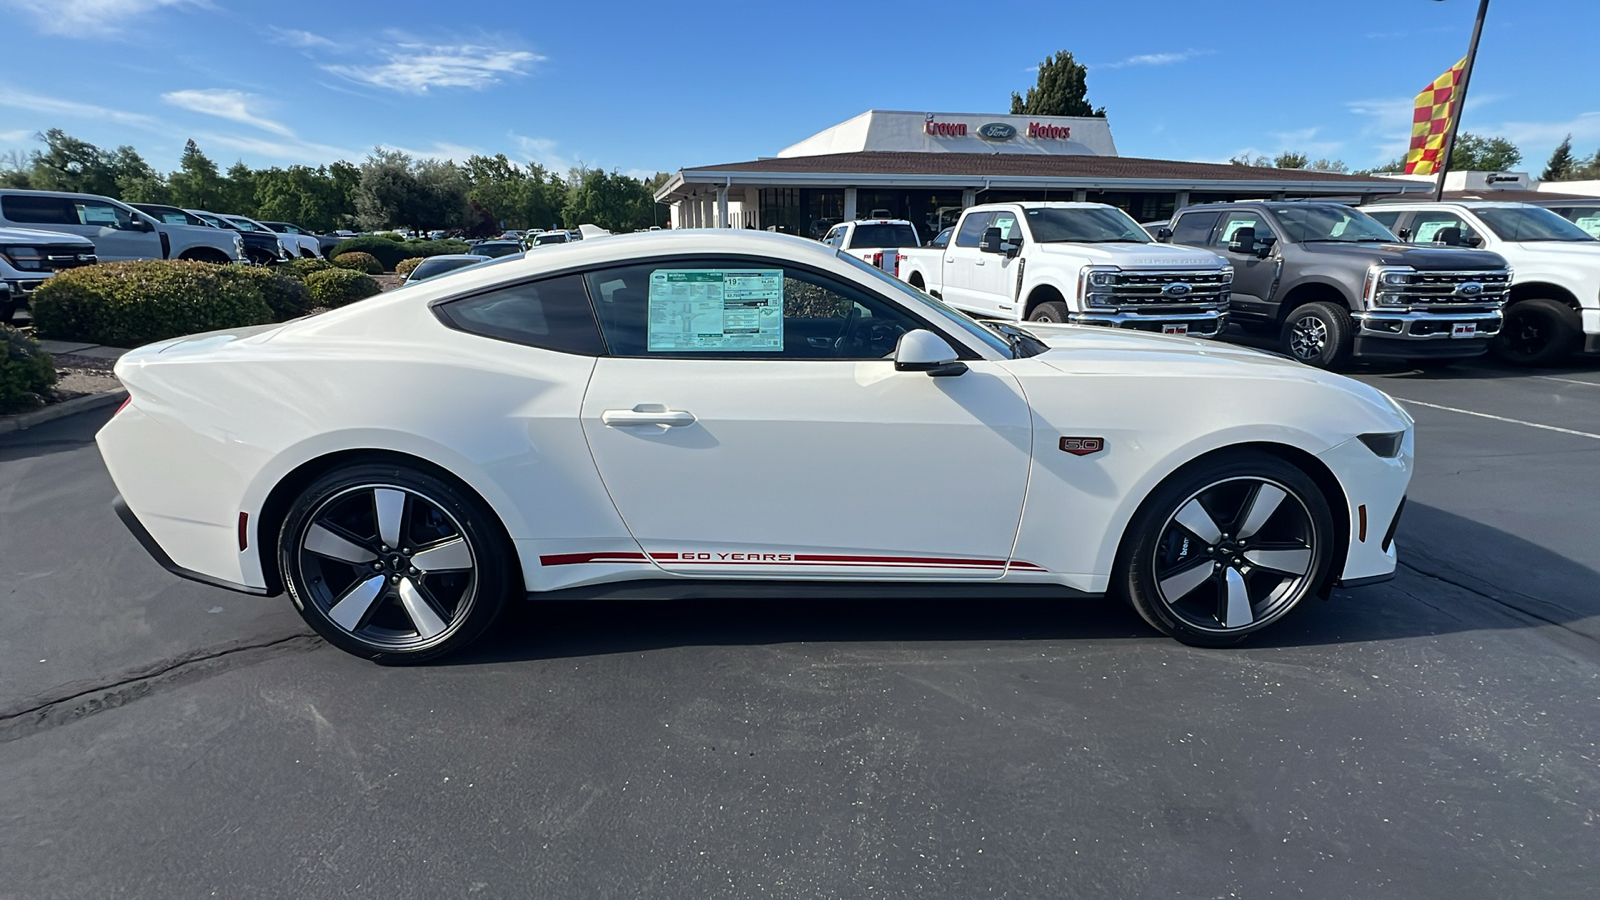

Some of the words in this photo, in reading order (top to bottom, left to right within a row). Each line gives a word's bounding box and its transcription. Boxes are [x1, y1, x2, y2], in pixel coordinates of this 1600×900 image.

[926, 119, 968, 136] Crown
[987, 126, 1010, 137] Ford
[1028, 122, 1071, 139] Motors
[1064, 439, 1100, 450] 5.0
[1179, 537, 1189, 556] brem
[681, 552, 711, 560] 60
[717, 552, 792, 561] YEARS
